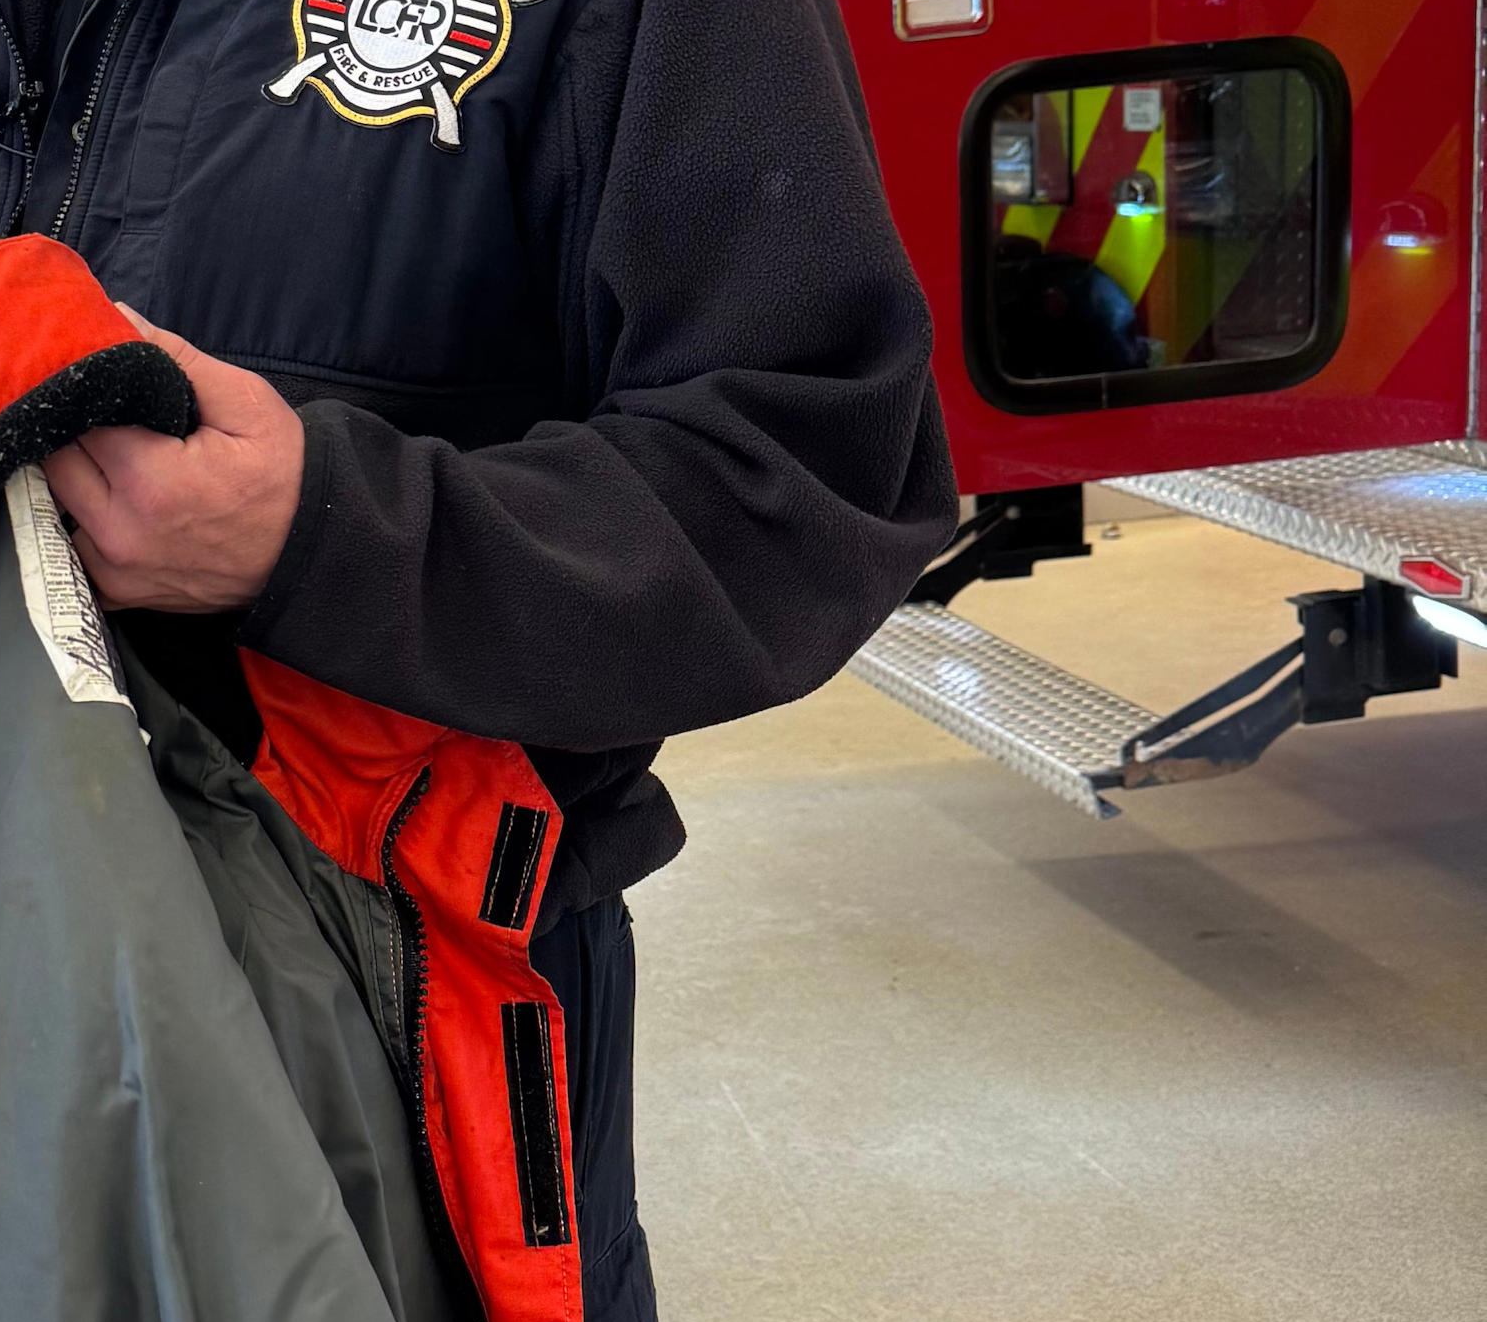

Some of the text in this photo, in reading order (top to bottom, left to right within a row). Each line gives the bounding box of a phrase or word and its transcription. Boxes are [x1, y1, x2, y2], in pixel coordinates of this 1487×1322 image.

[333, 47, 433, 88] FIRE & RESCUE
